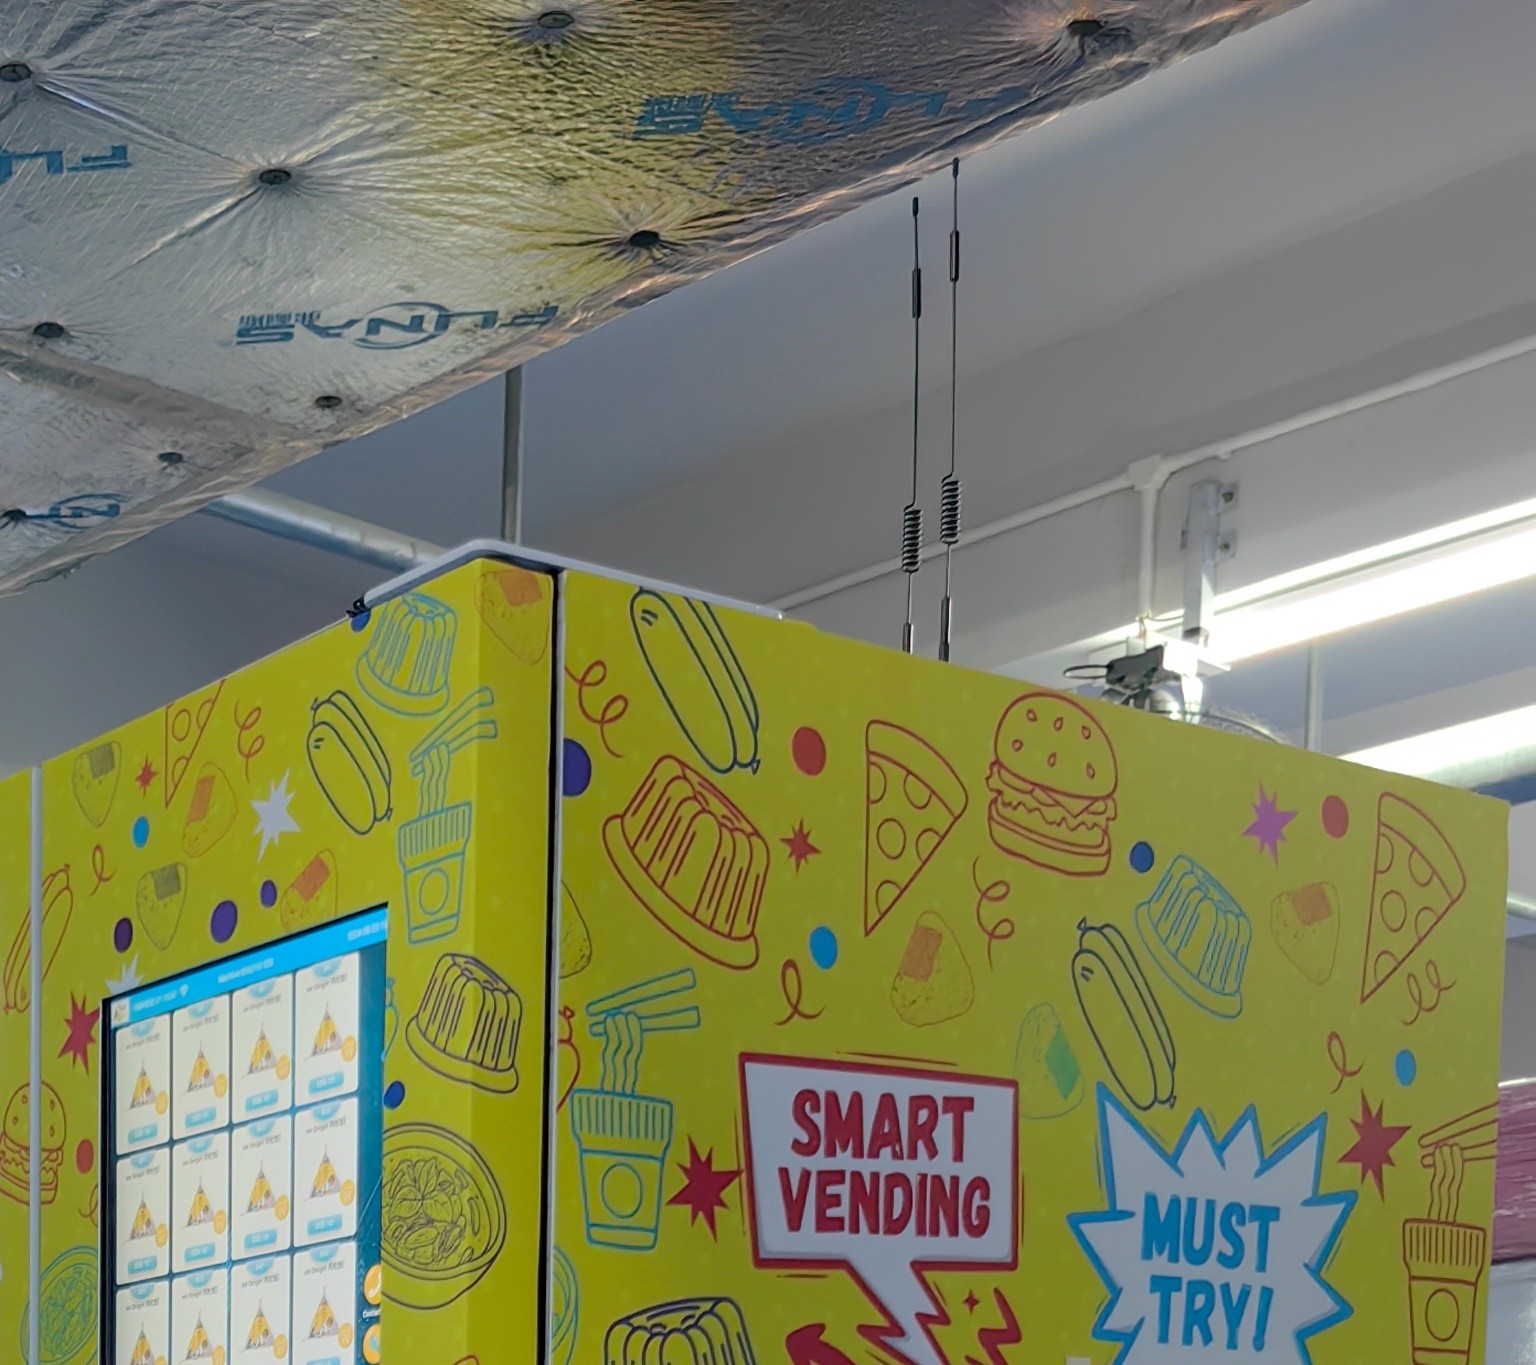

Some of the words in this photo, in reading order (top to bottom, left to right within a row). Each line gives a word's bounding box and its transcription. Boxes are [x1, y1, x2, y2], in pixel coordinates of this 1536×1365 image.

[791, 1088, 975, 1163] SMART
[778, 1170, 991, 1239] VENDING
[1141, 1192, 1282, 1270] MUST
[1148, 1275, 1273, 1354] TRY!
